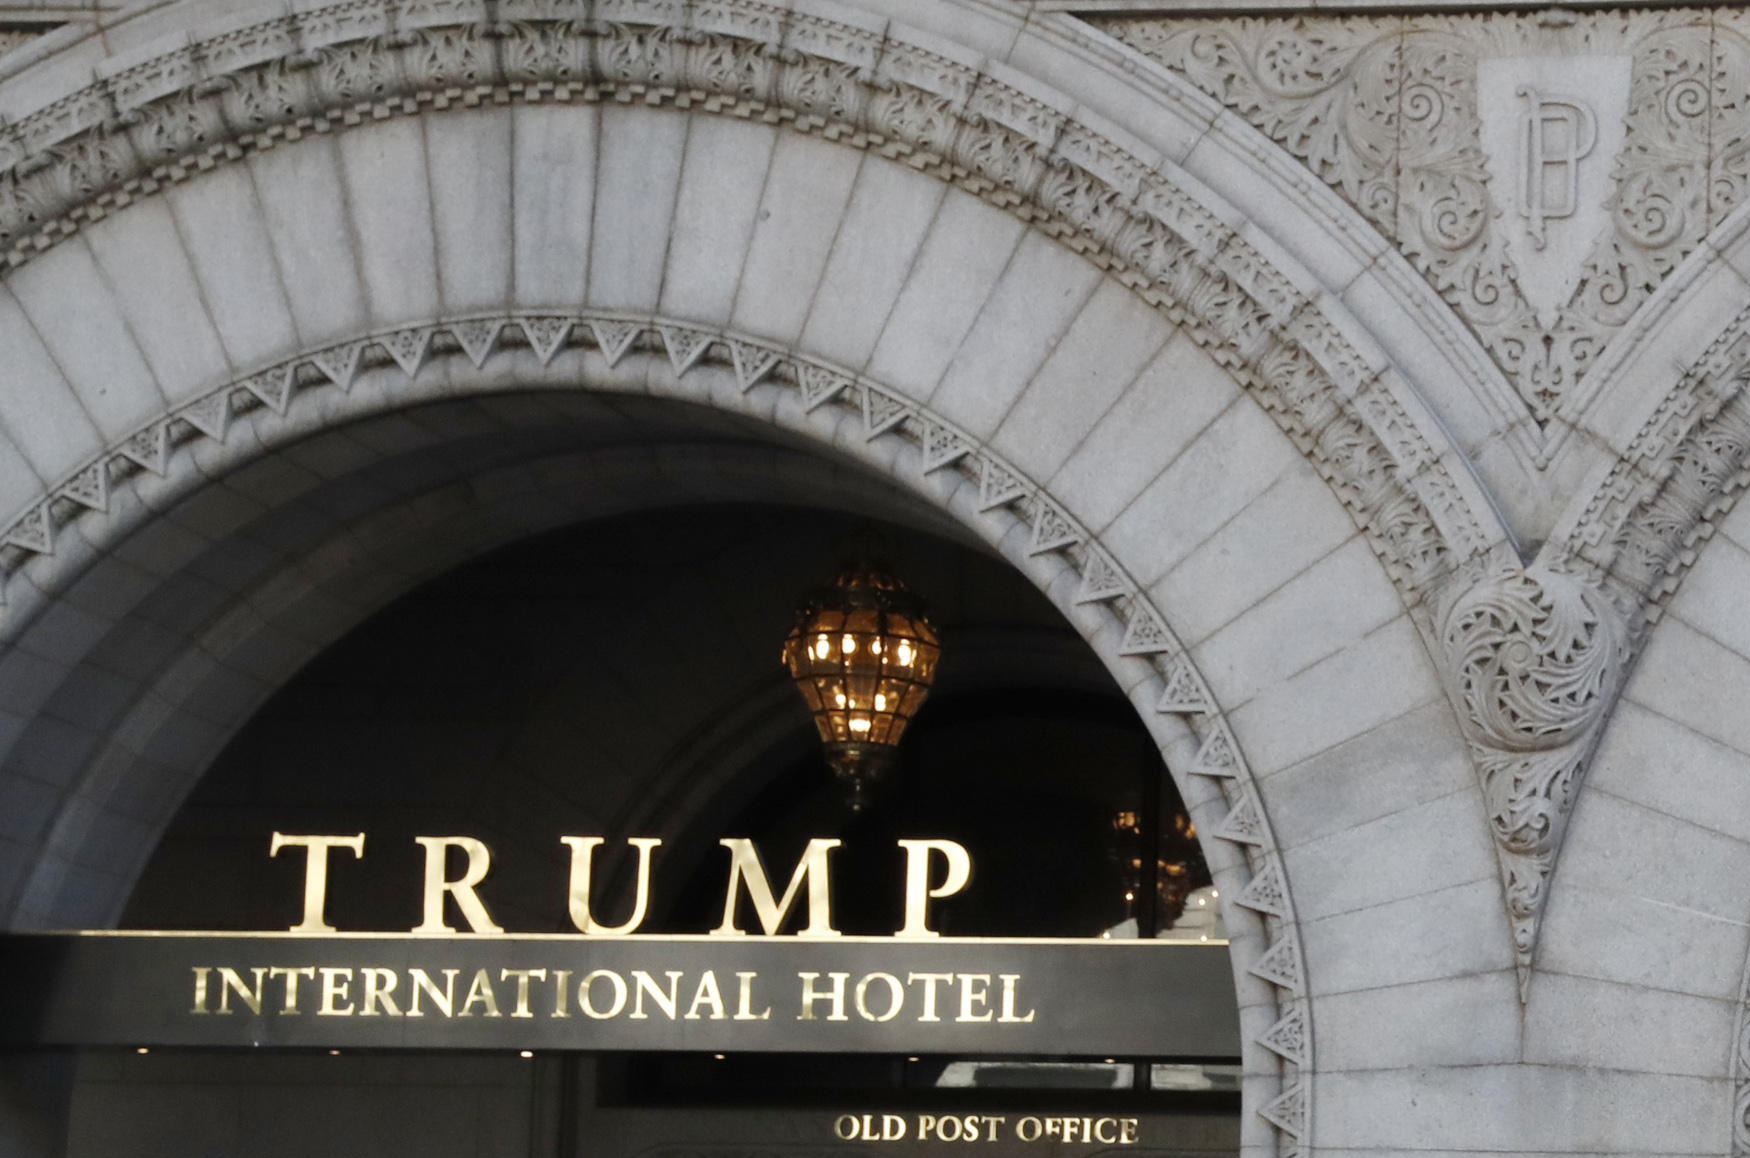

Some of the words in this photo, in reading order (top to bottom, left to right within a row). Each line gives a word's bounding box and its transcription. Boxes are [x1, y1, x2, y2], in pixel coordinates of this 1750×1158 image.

[270, 831, 972, 937] TRUMP
[190, 966, 770, 1021] INTERNATIONAL
[796, 971, 1036, 1023] HOTEL
[834, 1114, 907, 1141] OLD
[917, 1115, 1005, 1142] POST
[1016, 1116, 1140, 1144] OFFICE
